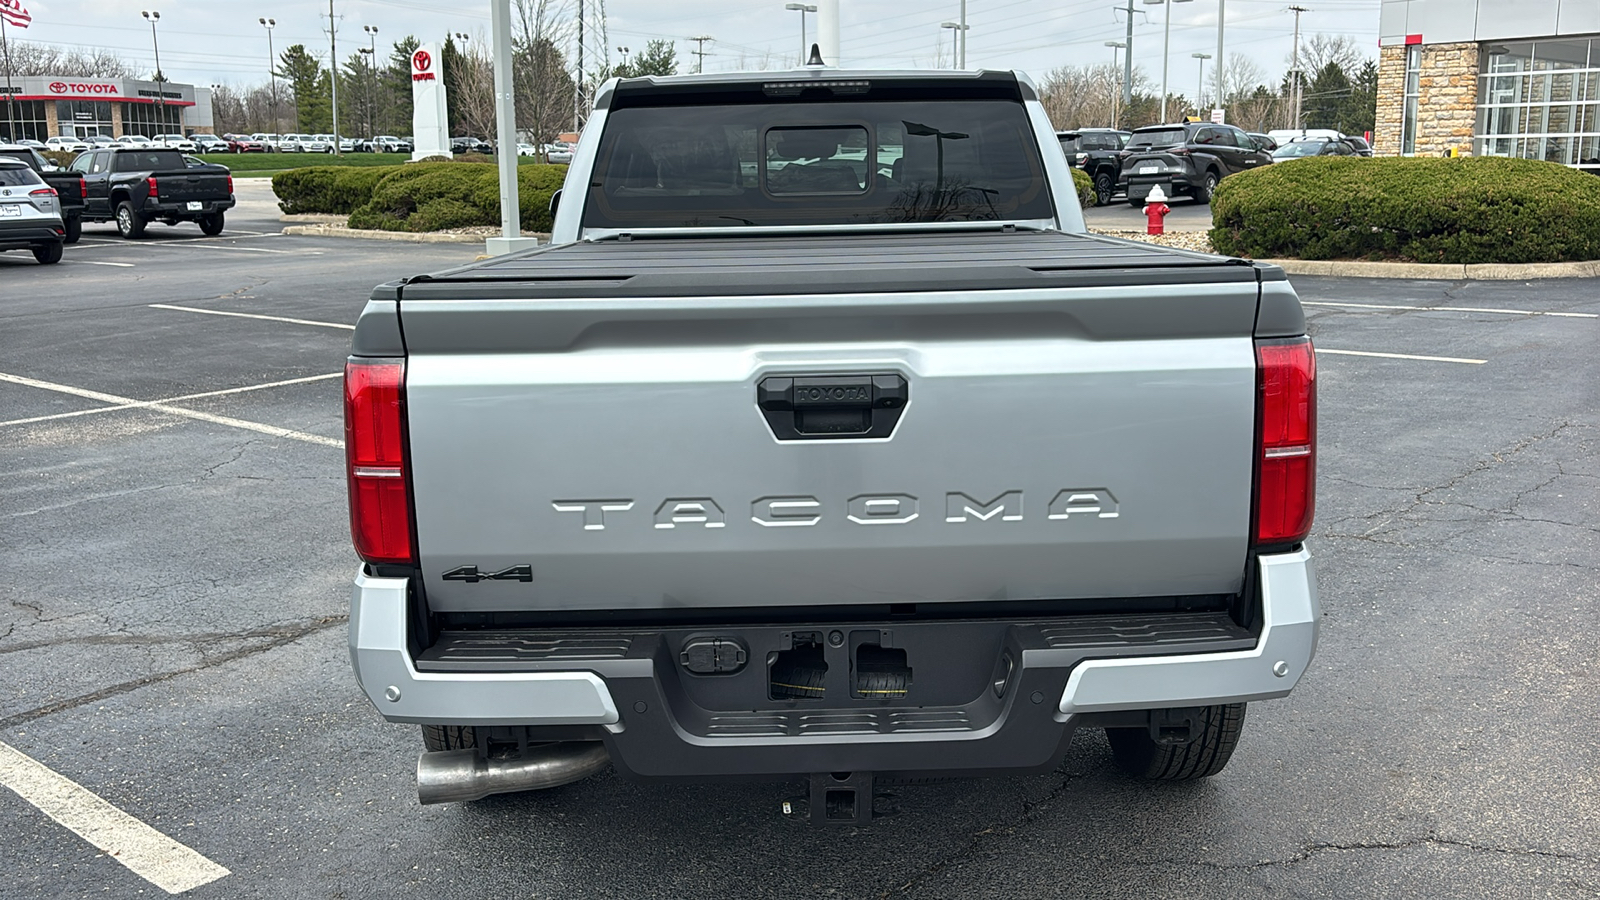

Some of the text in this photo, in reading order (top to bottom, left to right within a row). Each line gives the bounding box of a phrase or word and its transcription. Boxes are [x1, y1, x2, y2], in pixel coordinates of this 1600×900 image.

[69, 83, 118, 94] TOYOTA
[798, 386, 869, 401] TOYOTA
[551, 487, 1120, 531] TACOMA
